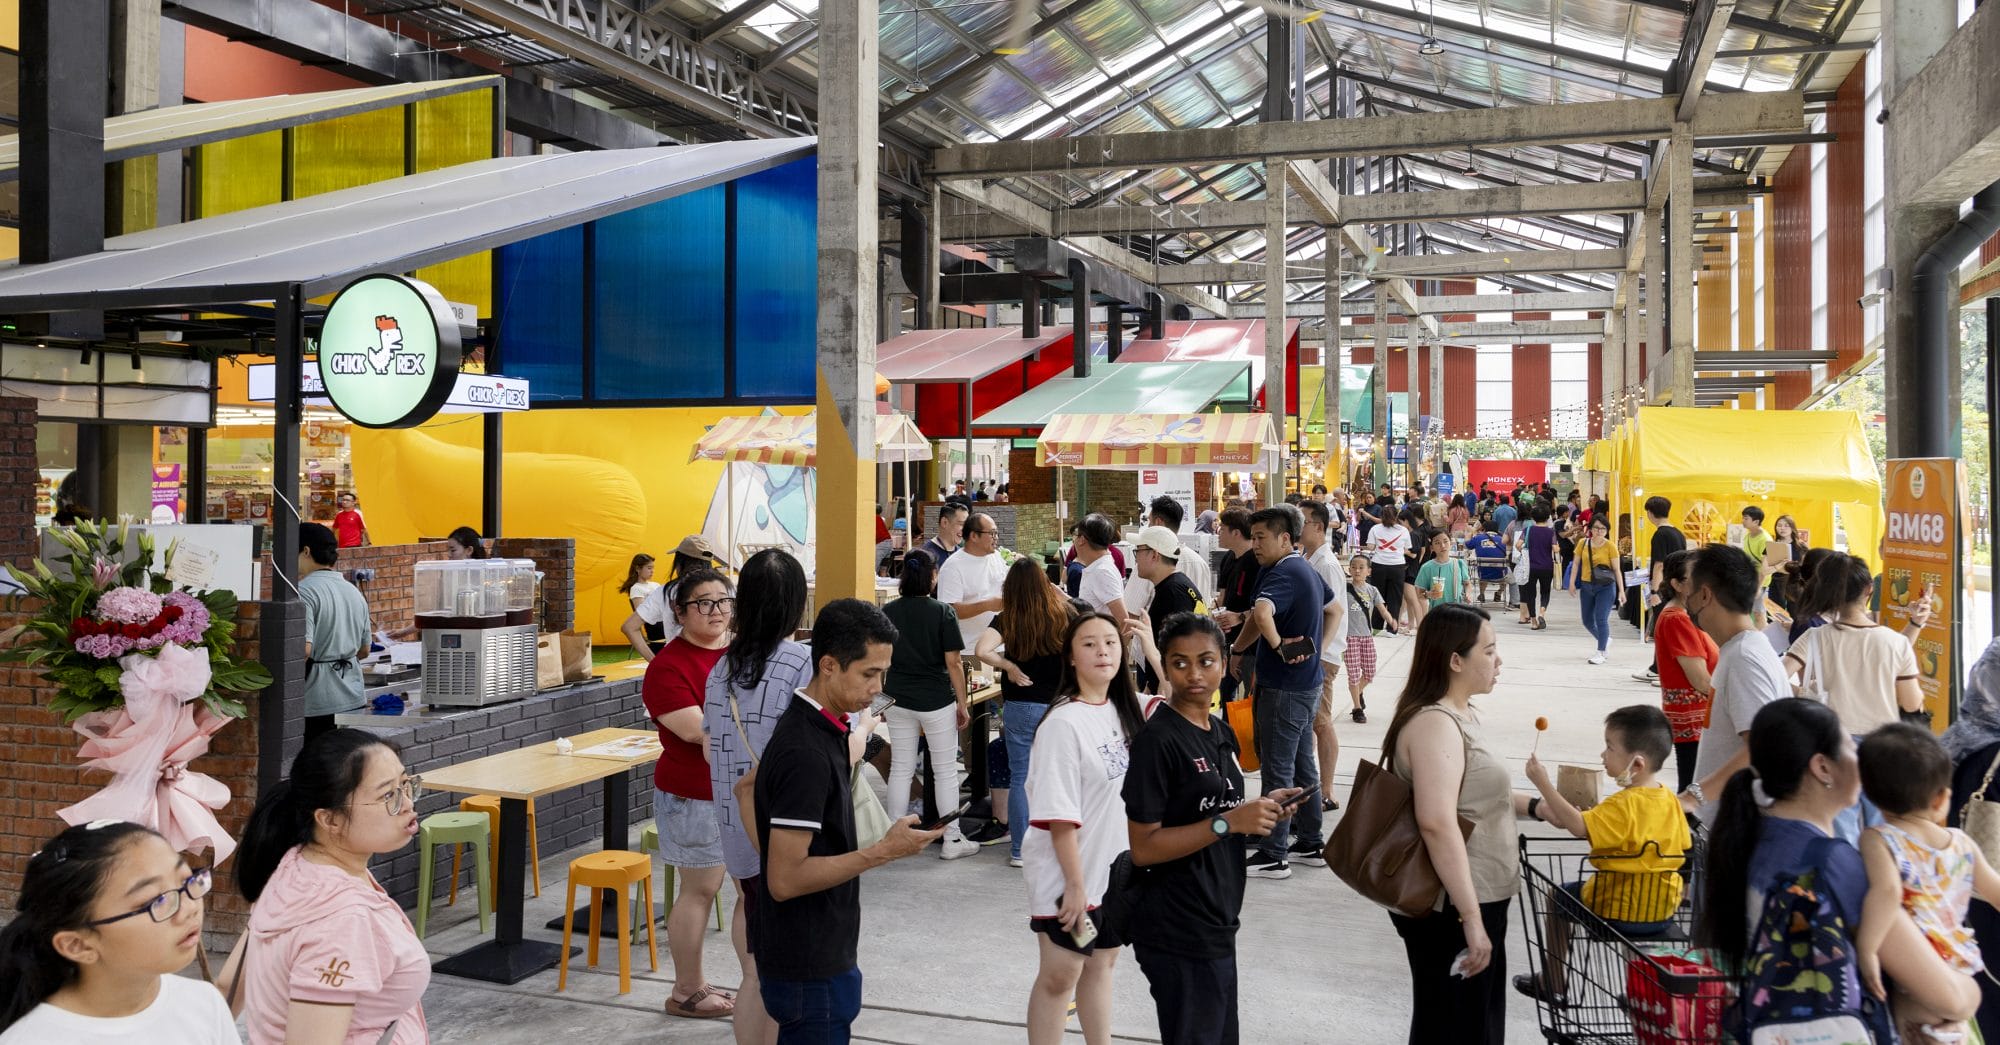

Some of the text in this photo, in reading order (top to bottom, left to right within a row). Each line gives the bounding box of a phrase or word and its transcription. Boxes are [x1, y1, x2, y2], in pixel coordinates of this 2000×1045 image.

[331, 353, 425, 375] CHICK REX
[313, 379, 325, 392] RE
[468, 385, 525, 406] CHICK REX
[1487, 475, 1526, 483] MONEYX
[1888, 512, 1945, 544] RM68
